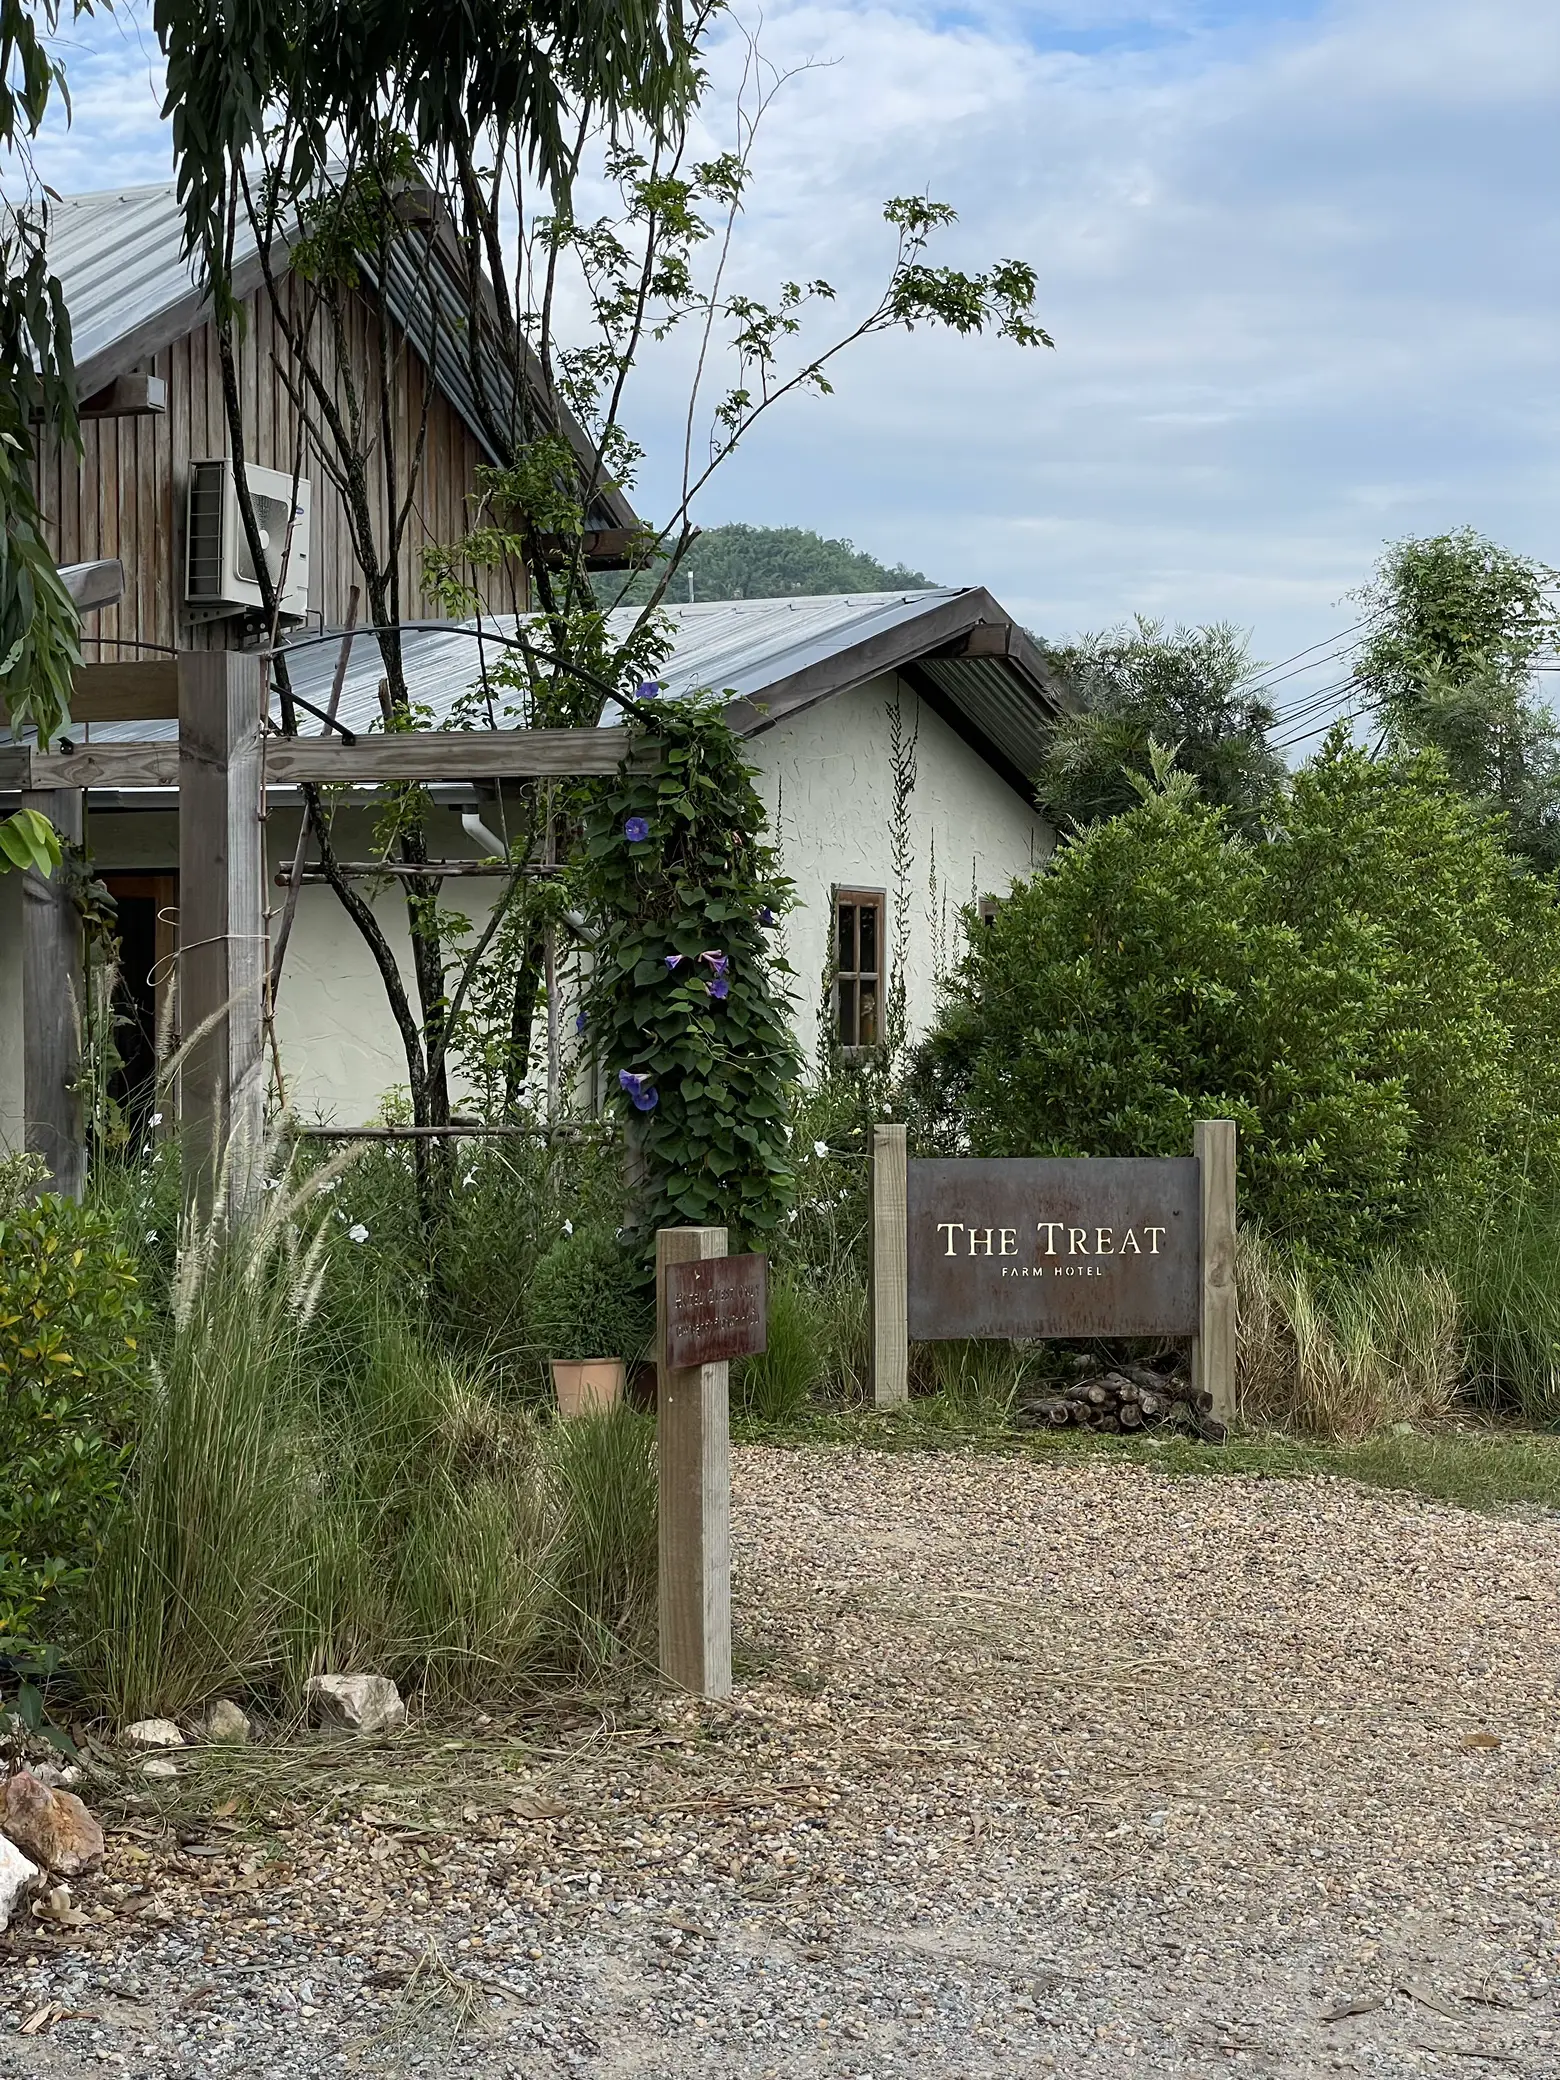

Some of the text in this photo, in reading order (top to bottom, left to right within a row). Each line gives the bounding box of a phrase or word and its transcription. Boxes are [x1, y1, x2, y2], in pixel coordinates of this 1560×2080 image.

[937, 1222, 1166, 1256] THE TREAT
[1002, 1266, 1102, 1277] FARM HOTEL
